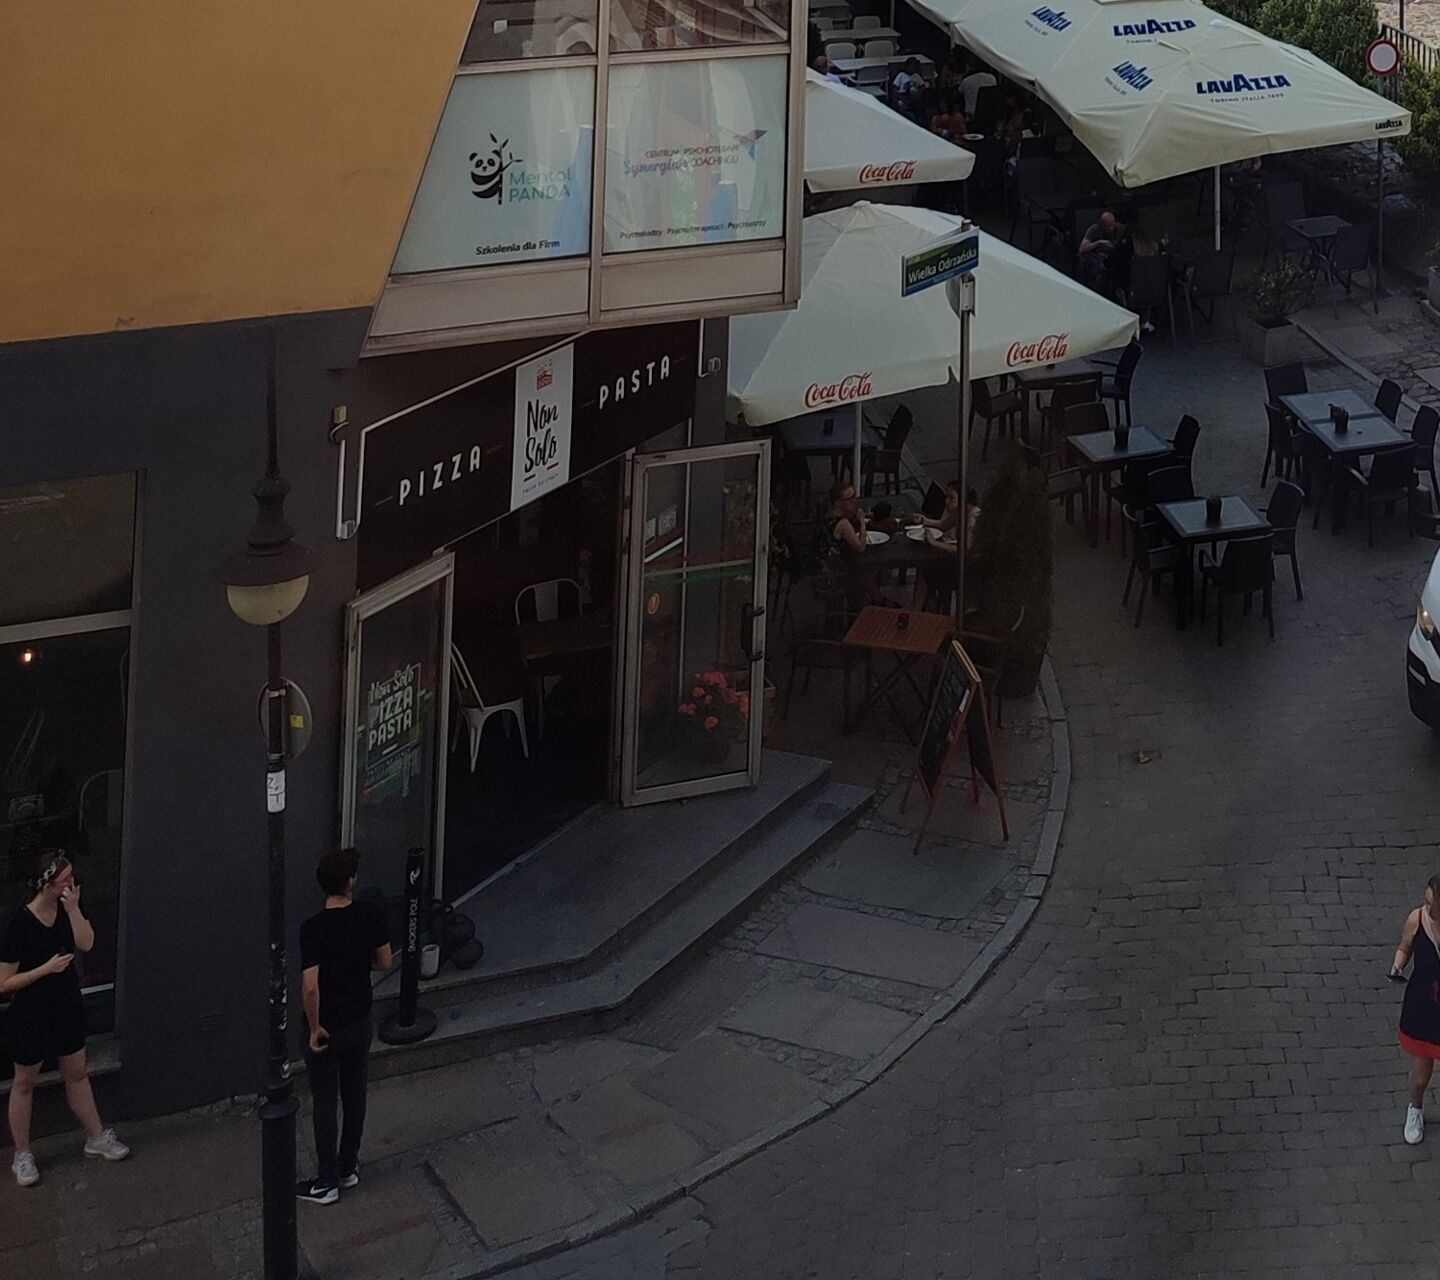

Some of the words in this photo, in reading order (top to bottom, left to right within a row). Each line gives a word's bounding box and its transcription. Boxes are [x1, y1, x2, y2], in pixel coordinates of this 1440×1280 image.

[1113, 19, 1197, 37] LAVAZZA
[1196, 73, 1292, 95] LAVAZZA
[1375, 119, 1403, 130] LAVAZZA
[509, 167, 571, 186] Mental
[858, 159, 918, 184] Coca-Cola
[509, 184, 571, 203] PANDA
[476, 243, 521, 256] Szkolenia
[522, 241, 537, 251] dla
[539, 240, 560, 249] Firm
[908, 264, 937, 284] Wielka
[938, 247, 977, 272] Odrzańska
[1006, 332, 1070, 368] Coca-Cola
[599, 355, 670, 409] PASTA
[804, 371, 873, 409] Coca-Cola
[526, 398, 559, 438] Non
[524, 428, 558, 473] Solo
[399, 445, 481, 506] PIZZA
[368, 708, 413, 751] PASTA
